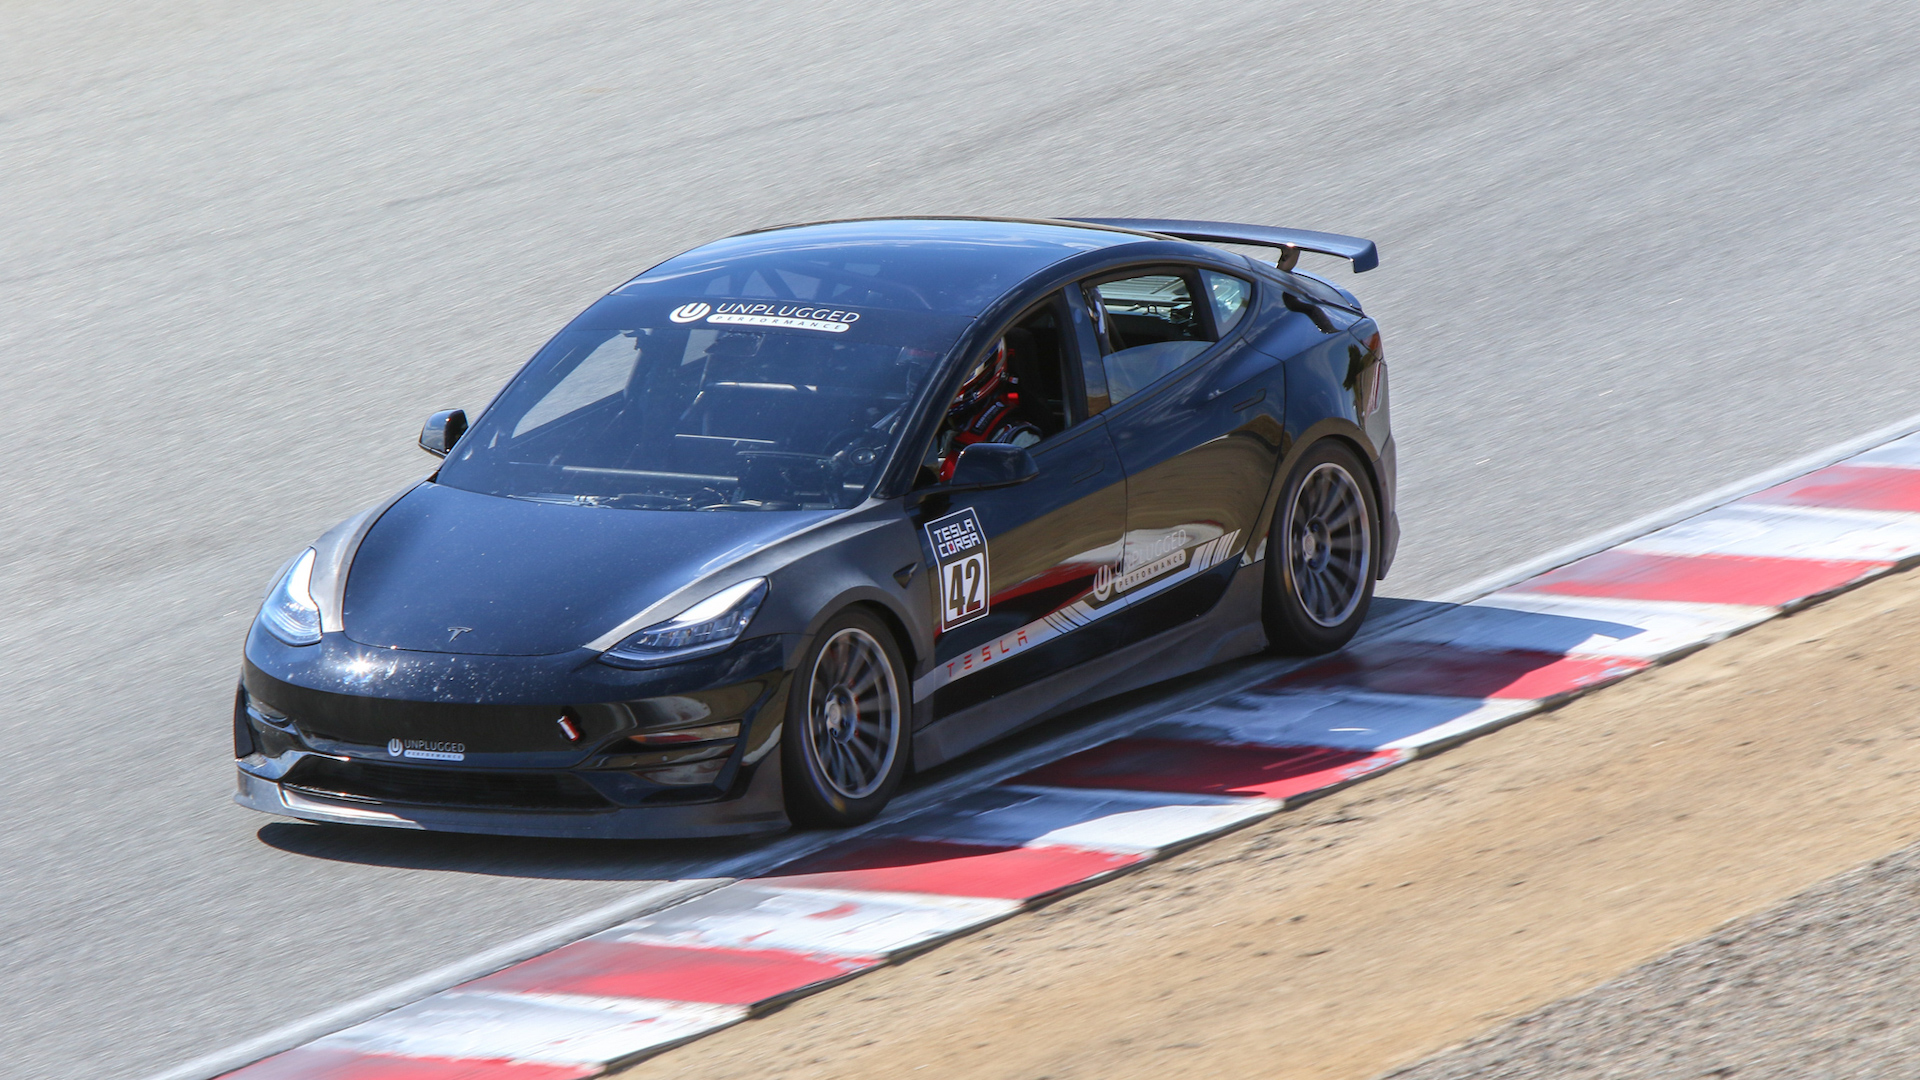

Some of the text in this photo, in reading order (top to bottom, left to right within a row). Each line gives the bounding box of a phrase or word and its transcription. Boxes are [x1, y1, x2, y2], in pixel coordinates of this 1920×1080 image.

[716, 303, 861, 323] UNPLUGGED
[716, 316, 841, 330] PERFORMANCE
[933, 518, 976, 543] TESLA
[937, 533, 981, 558] CORSA
[1119, 553, 1183, 588] PERFORMANCE
[949, 558, 981, 617] 42
[947, 630, 1028, 677] TESLA
[404, 739, 465, 753] UNPLUGGED
